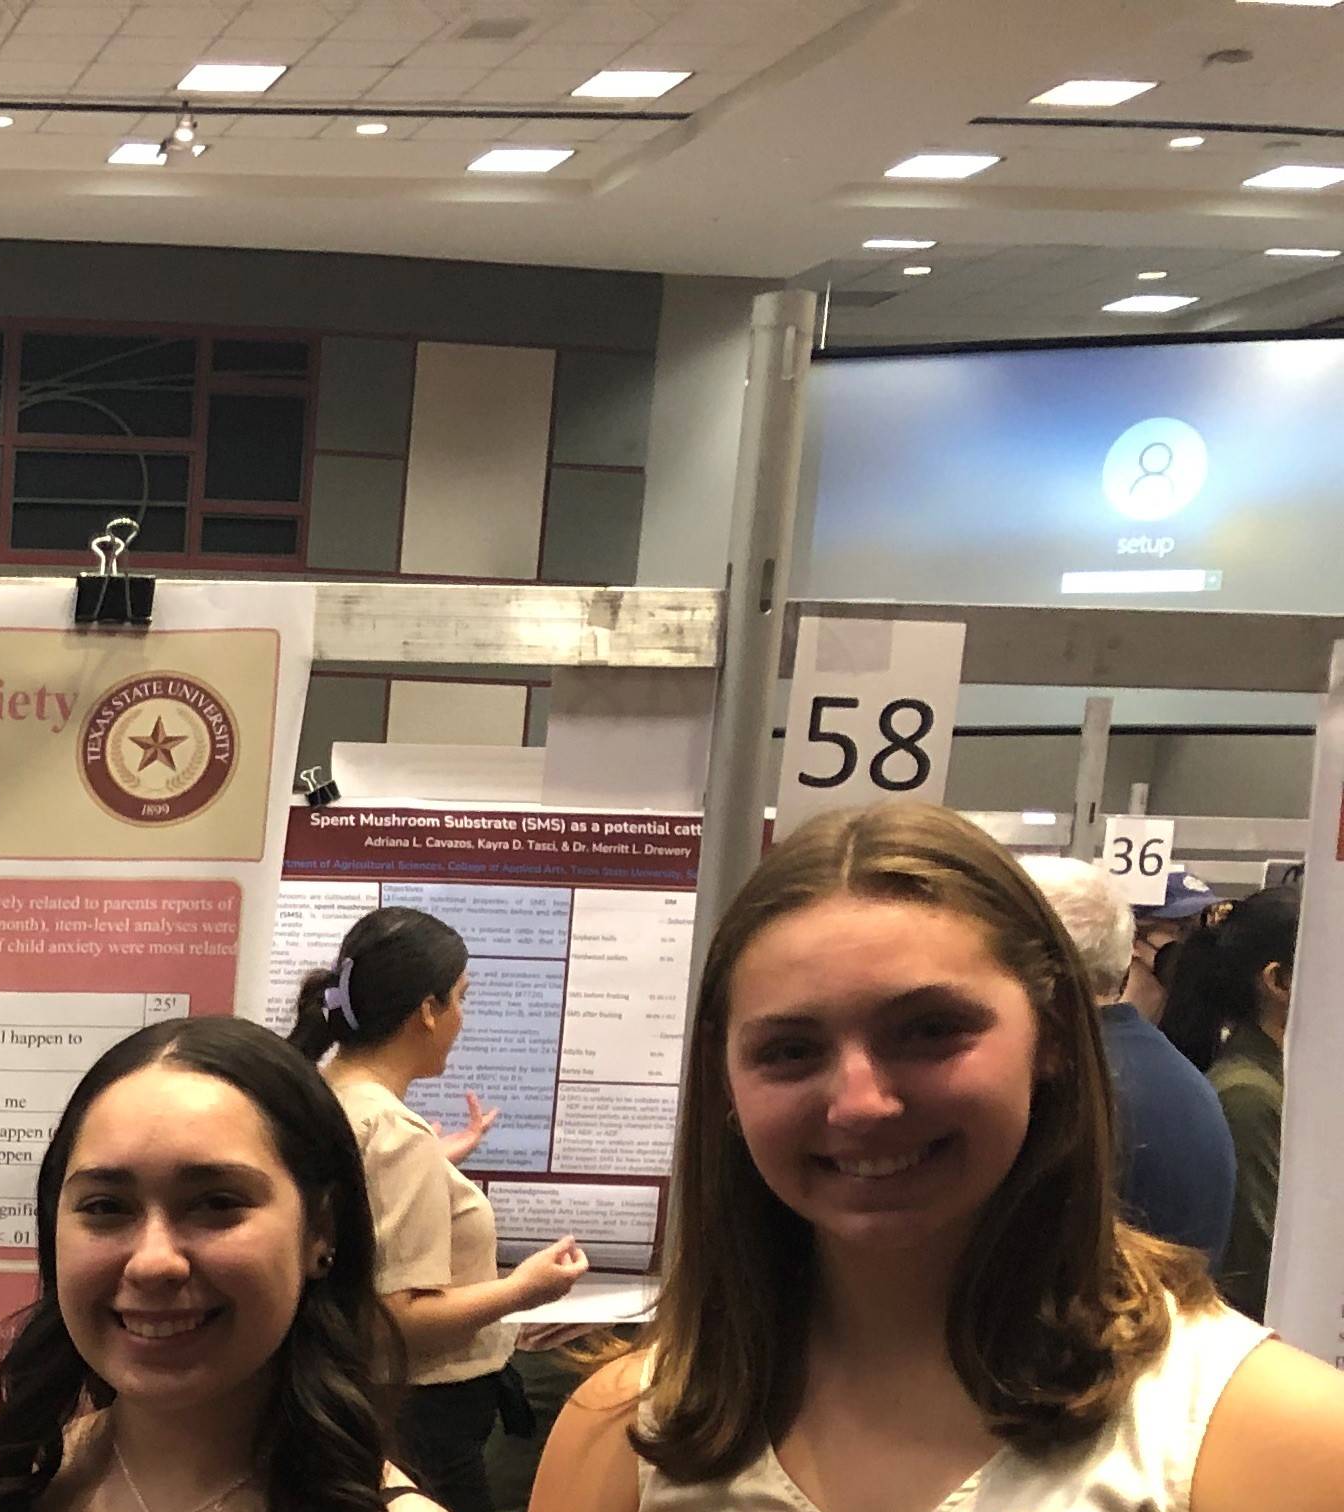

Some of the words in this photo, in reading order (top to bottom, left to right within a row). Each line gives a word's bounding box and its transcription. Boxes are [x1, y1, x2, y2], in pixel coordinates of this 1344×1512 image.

[1117, 533, 1175, 558] setup
[87, 707, 114, 764] TEXAS
[112, 681, 162, 710] STATE
[168, 681, 230, 764] UNIVERSITY
[797, 696, 935, 791] 58
[141, 803, 170, 816] 1899
[311, 813, 354, 828] Spent
[360, 813, 439, 827] Mushroom
[444, 815, 516, 829] Substrate
[522, 817, 564, 833] (SMS)
[570, 822, 586, 831] as
[591, 822, 599, 832] a
[604, 820, 669, 836] potential
[364, 836, 409, 847] Adriana
[412, 837, 421, 847] L.
[426, 836, 473, 848] Cavazos,
[478, 838, 509, 850] Kayra
[512, 839, 522, 850] D.
[527, 839, 557, 851] Tasci,
[561, 841, 569, 851] &
[572, 841, 588, 852] Dr.
[592, 842, 628, 853] Merritt
[632, 844, 640, 854] L.
[644, 844, 690, 857] Drewery
[1109, 837, 1164, 878] 36
[8, 938, 44, 952] child
[48, 939, 101, 956] anxiety
[108, 943, 144, 953] were
[149, 943, 184, 954] most
[11, 1030, 62, 1048] happen
[68, 1033, 82, 1044] to
[5, 1098, 25, 1108] me
